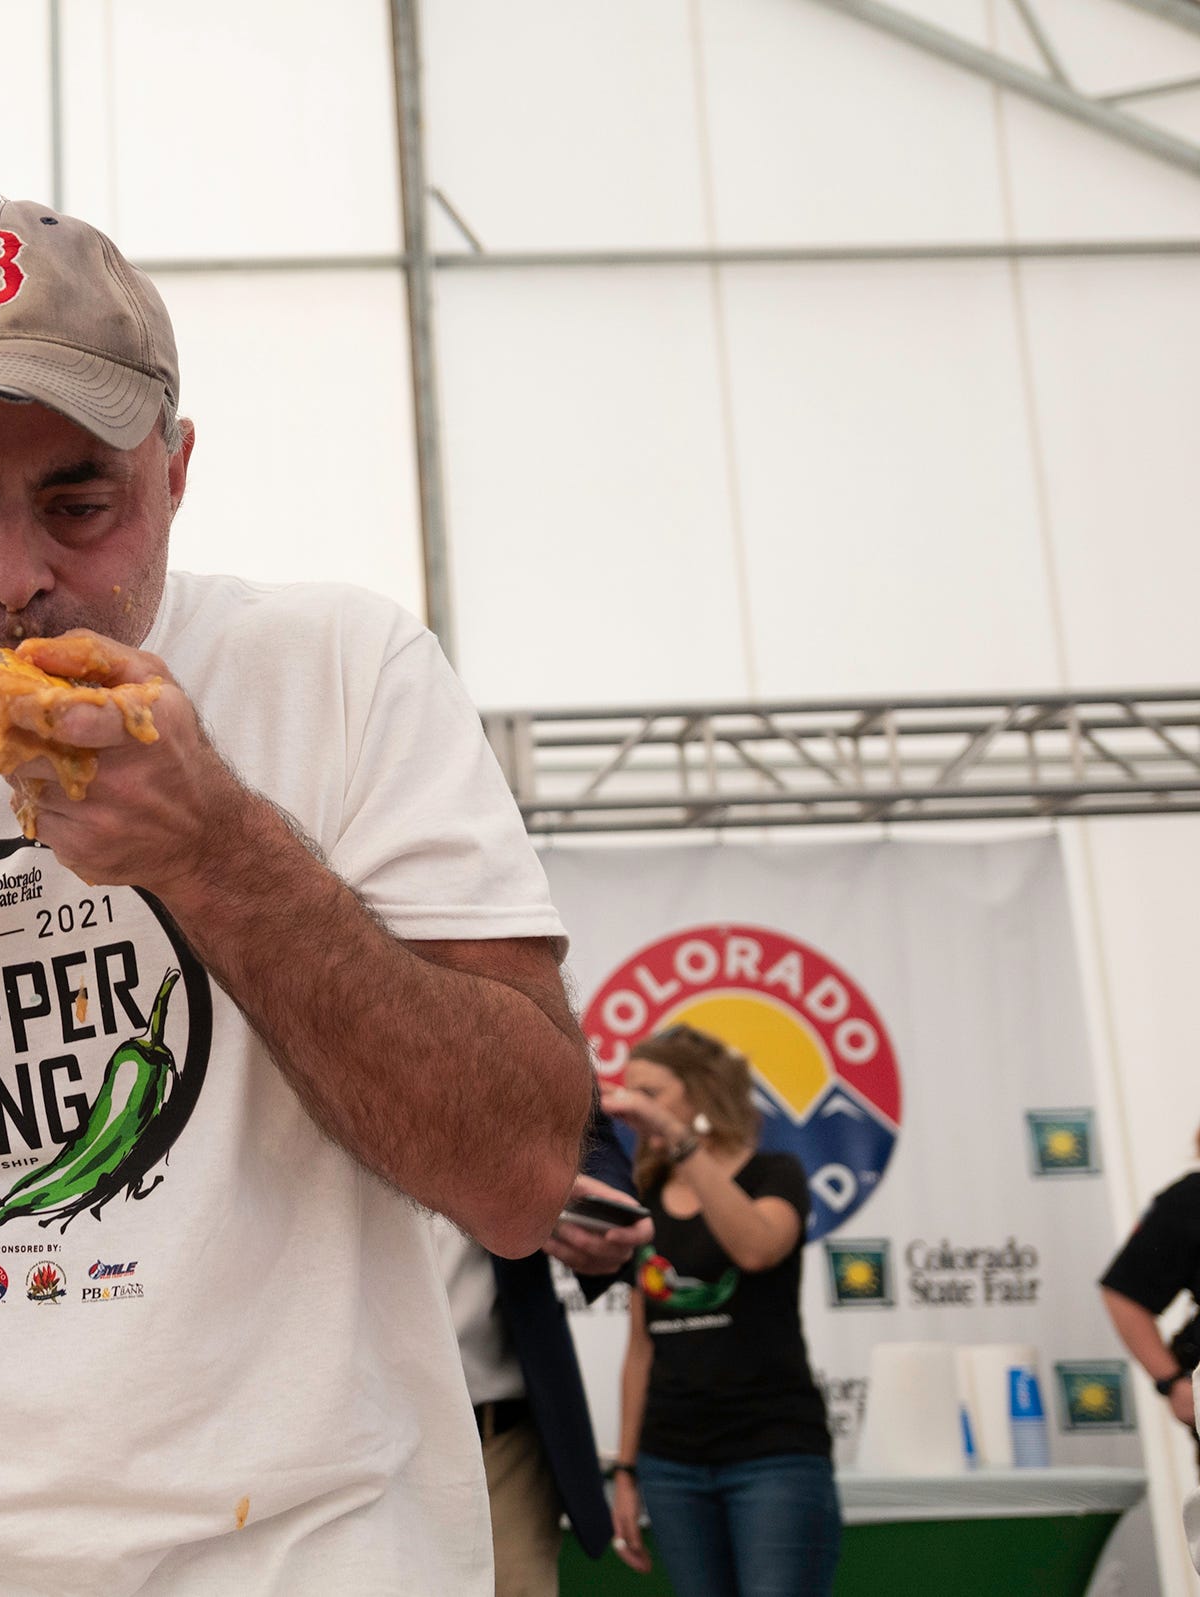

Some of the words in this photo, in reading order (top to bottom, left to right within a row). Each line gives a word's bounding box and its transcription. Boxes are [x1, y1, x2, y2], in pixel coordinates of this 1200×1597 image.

[20, 882, 43, 903] Fair
[36, 894, 114, 939] 2021
[594, 936, 881, 1076] COLORADO
[47, 1244, 62, 1252] BY:
[905, 1236, 1038, 1270] Colorado
[102, 1261, 138, 1277] MLE
[909, 1270, 975, 1306] State
[983, 1269, 1040, 1305] Fair
